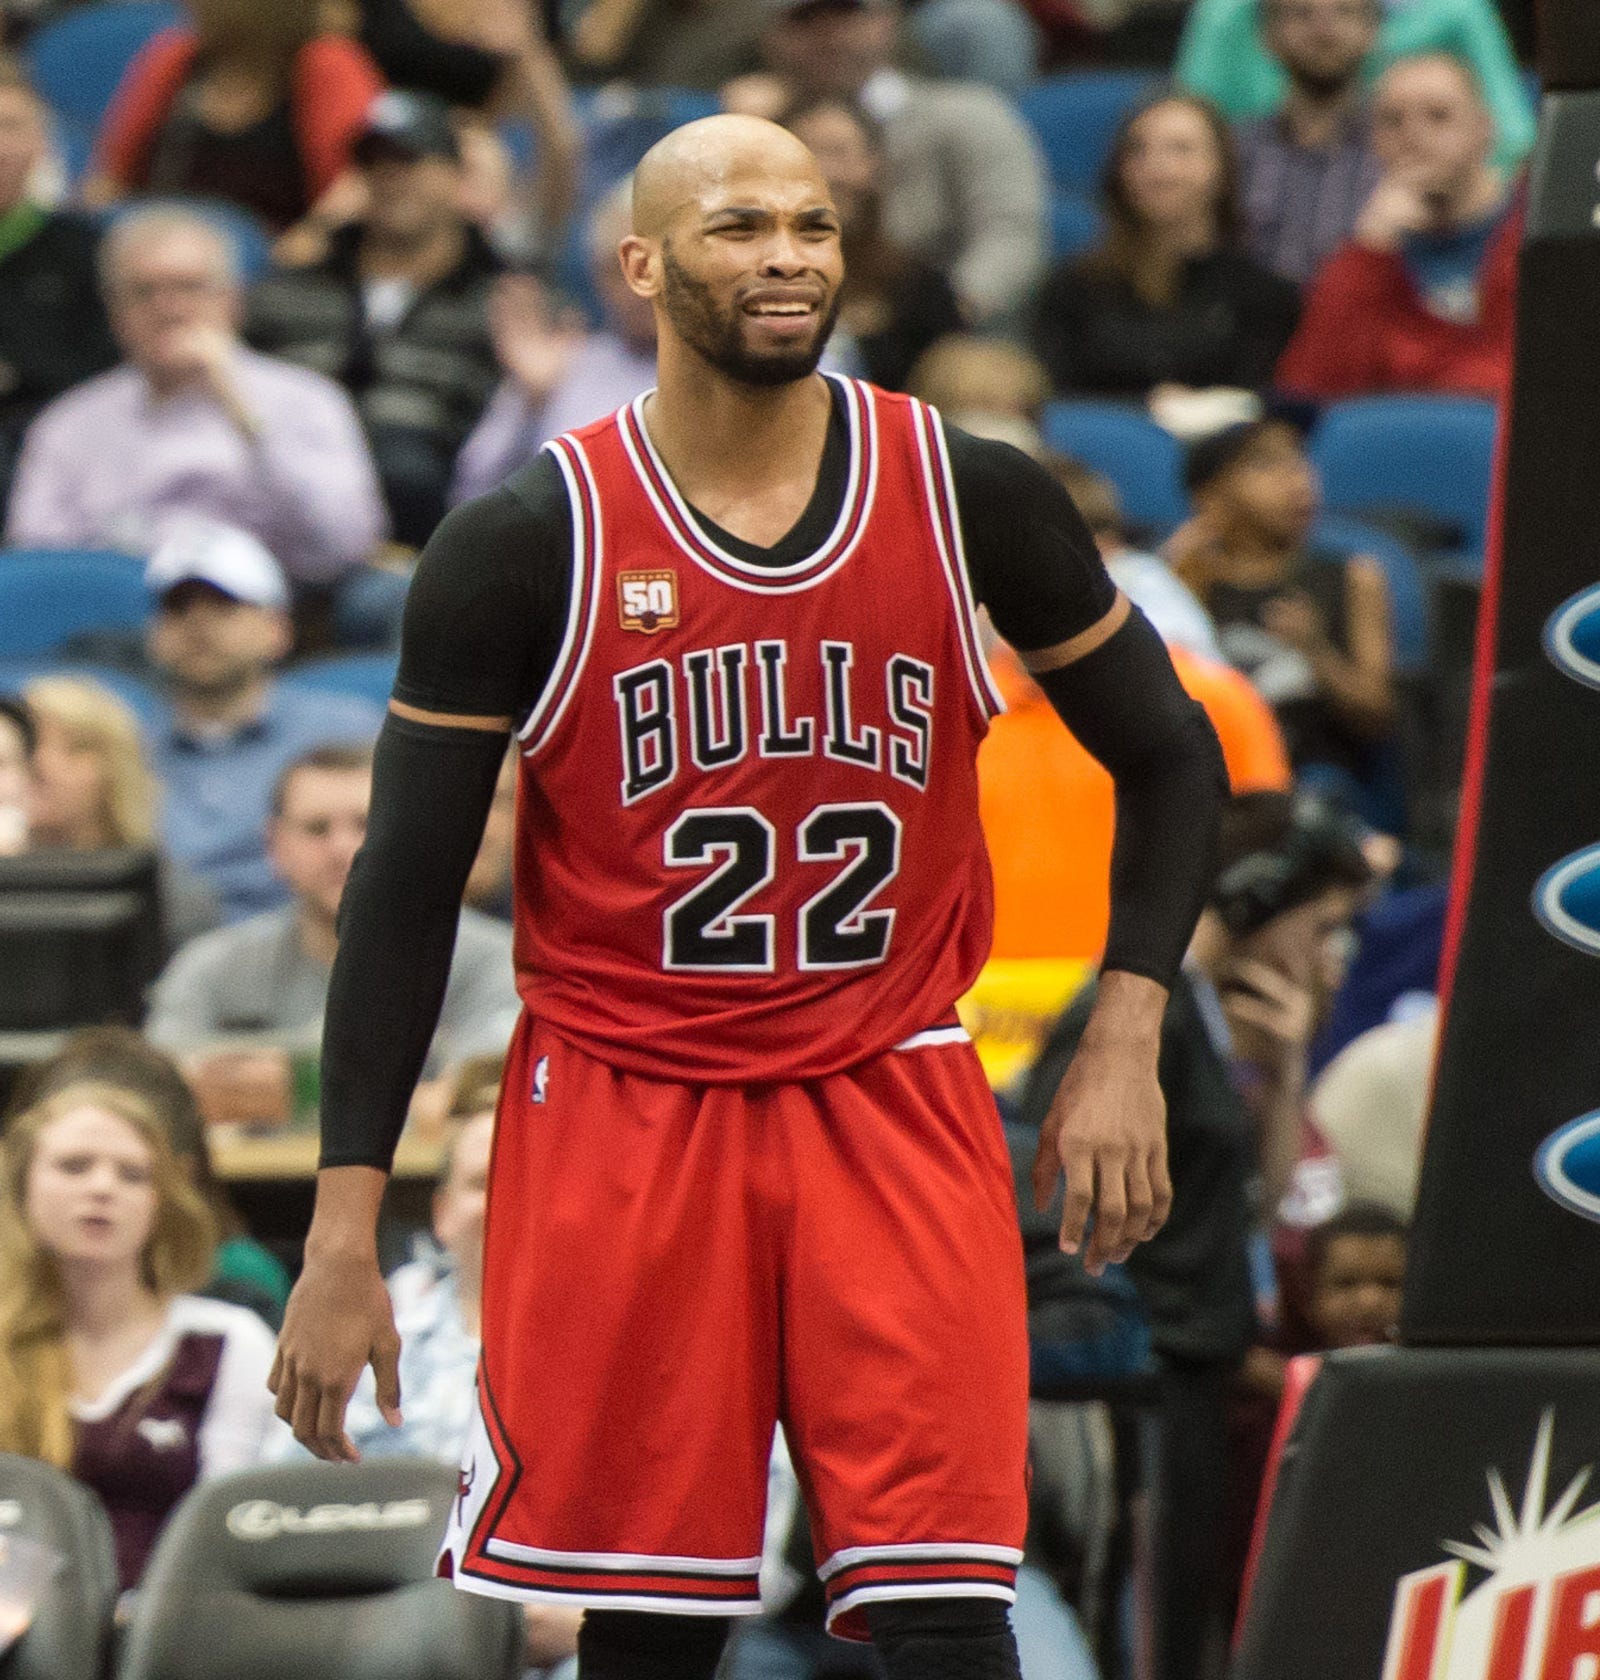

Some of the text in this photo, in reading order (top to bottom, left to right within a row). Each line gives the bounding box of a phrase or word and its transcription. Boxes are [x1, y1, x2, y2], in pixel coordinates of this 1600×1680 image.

[622, 579, 673, 617] 50
[612, 639, 935, 808] BULLS
[662, 800, 903, 973] 22
